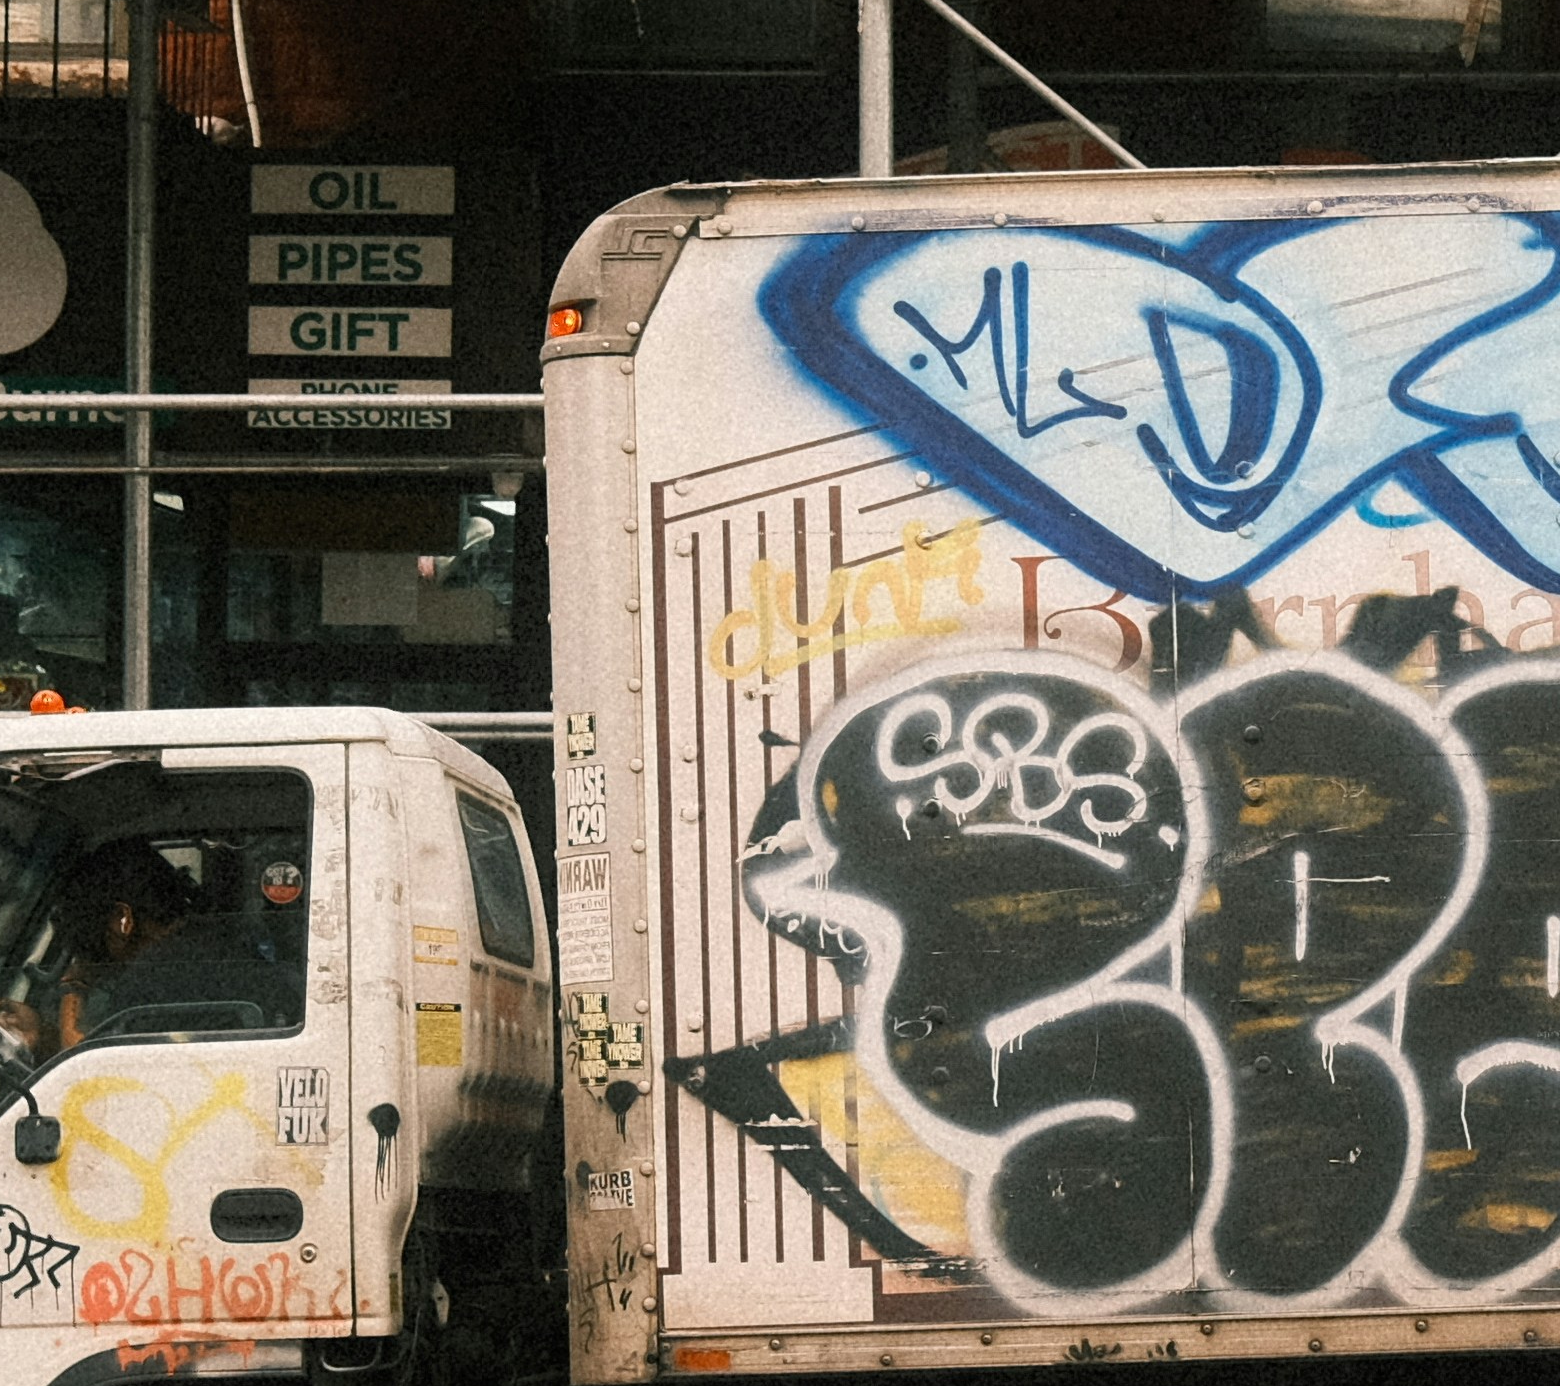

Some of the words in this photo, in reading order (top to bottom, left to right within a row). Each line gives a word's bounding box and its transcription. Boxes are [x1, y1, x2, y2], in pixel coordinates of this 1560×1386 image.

[308, 171, 398, 211] OIL
[278, 243, 424, 282] PIPES
[290, 312, 410, 352] GIFT
[251, 408, 450, 428] ACCESSORIES
[568, 804, 607, 846] 429
[277, 1107, 327, 1144] FUK
[590, 1170, 633, 1193] KURB
